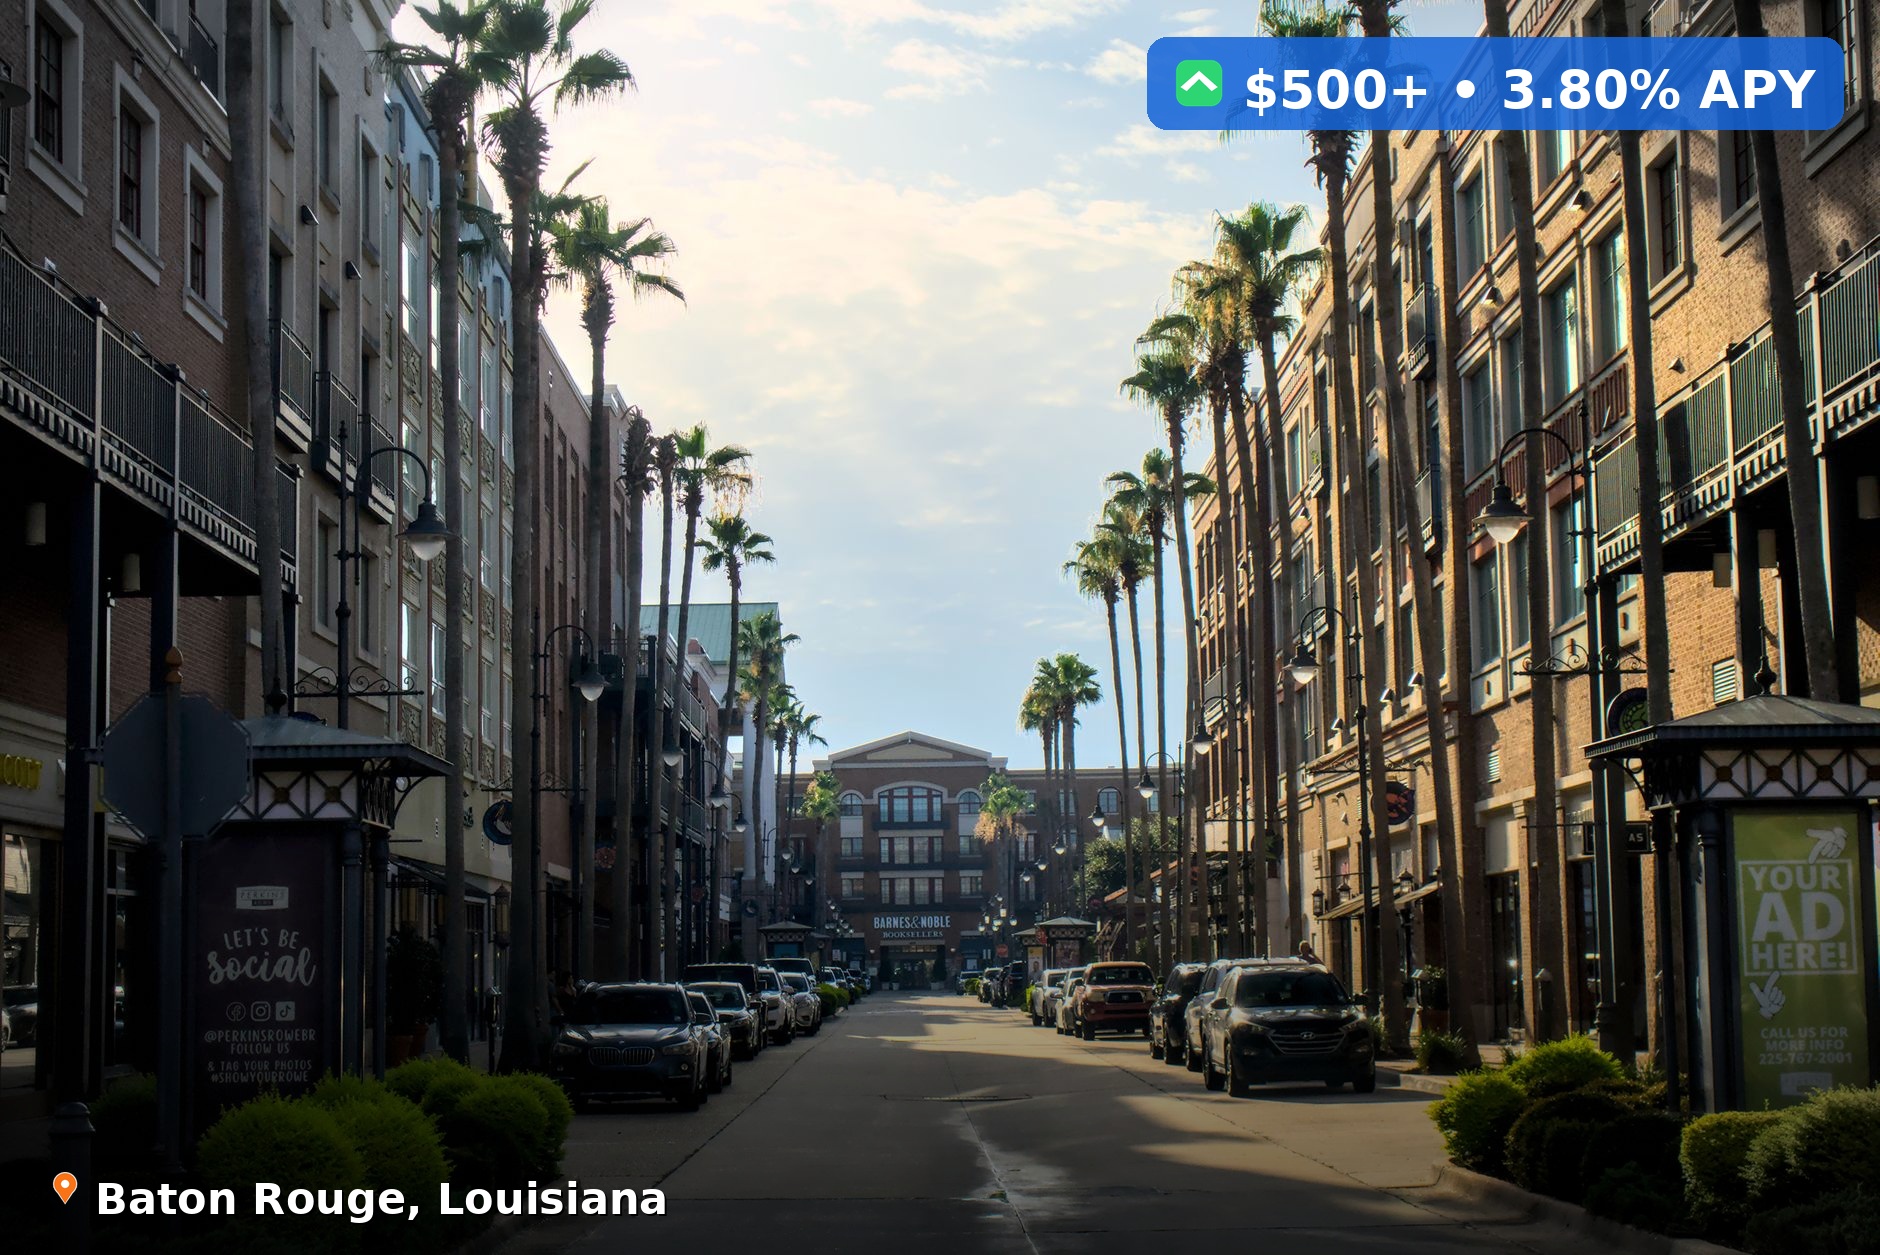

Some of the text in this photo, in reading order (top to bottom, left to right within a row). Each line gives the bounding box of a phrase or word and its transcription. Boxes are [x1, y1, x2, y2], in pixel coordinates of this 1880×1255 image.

[1747, 864, 1842, 891] YOUR
[1751, 891, 1846, 942] AD
[223, 927, 299, 950] LET'S BE
[883, 931, 944, 939] BOOKSELLERS
[1751, 942, 1847, 970] HERE!
[204, 1028, 316, 1043] @PERKINSROWEBR
[1760, 1026, 1849, 1039] CALL US FOR
[230, 1042, 290, 1055] FOLLOW US
[1765, 1039, 1845, 1051] MORE INFO
[1759, 1051, 1853, 1065] 225-767-2001
[220, 1060, 240, 1072] TAG
[244, 1060, 270, 1071] YOUR
[274, 1059, 313, 1071] PHOTOS
